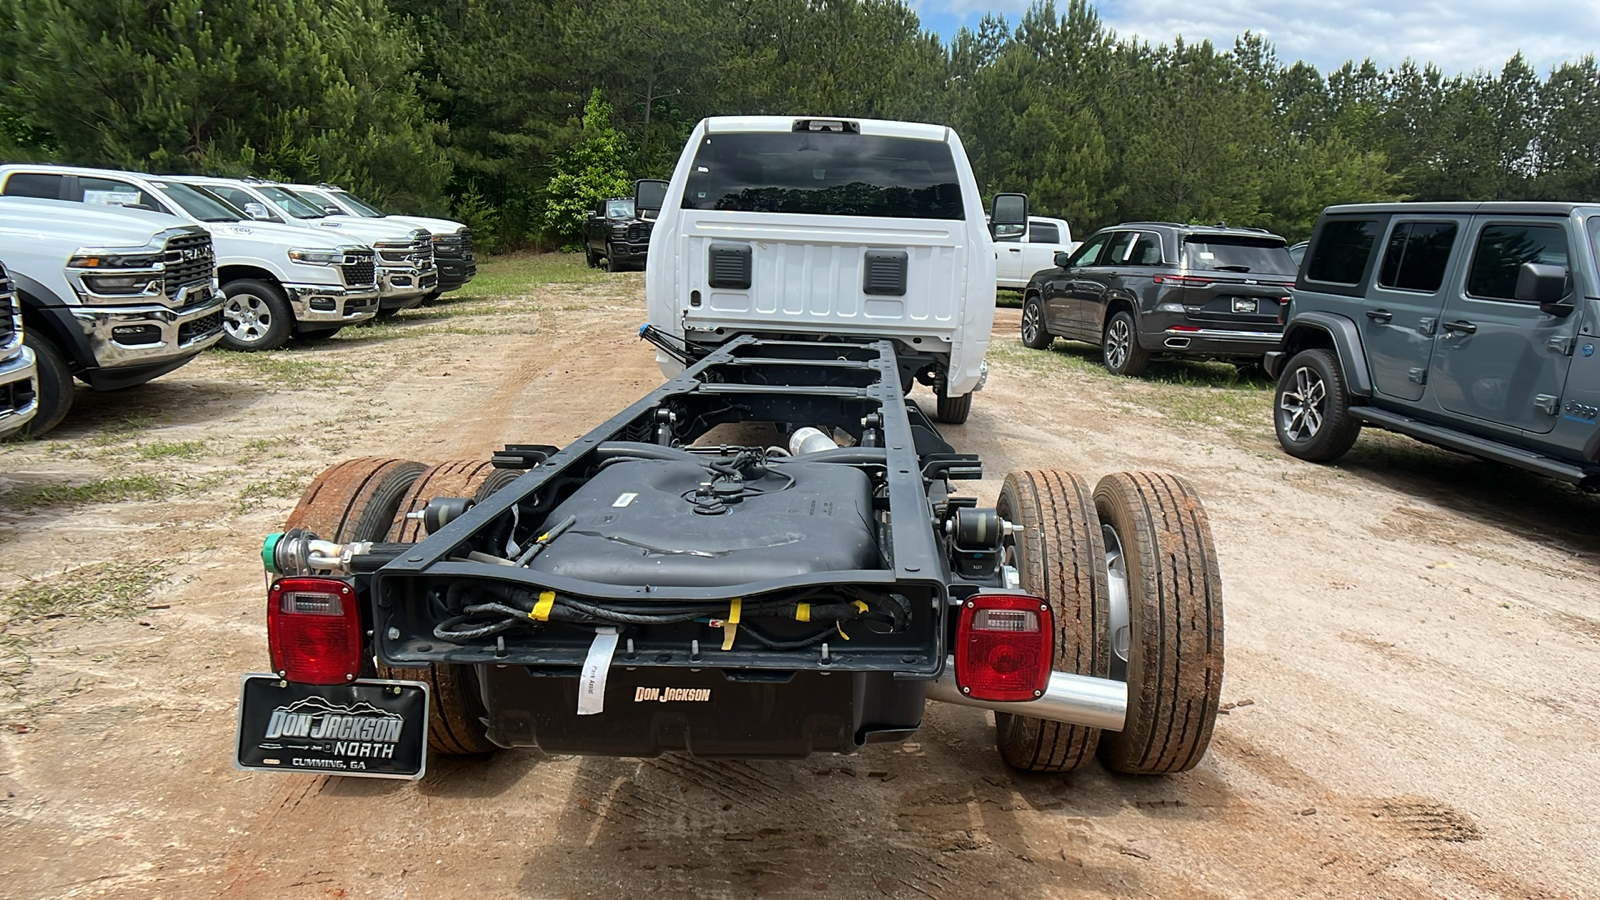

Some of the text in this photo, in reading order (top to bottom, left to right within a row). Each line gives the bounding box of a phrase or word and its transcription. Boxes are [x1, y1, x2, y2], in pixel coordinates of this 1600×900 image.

[1565, 399, 1599, 420] Jeep
[334, 742, 394, 758] NORTH
[292, 757, 367, 770] CUMMING, GA
